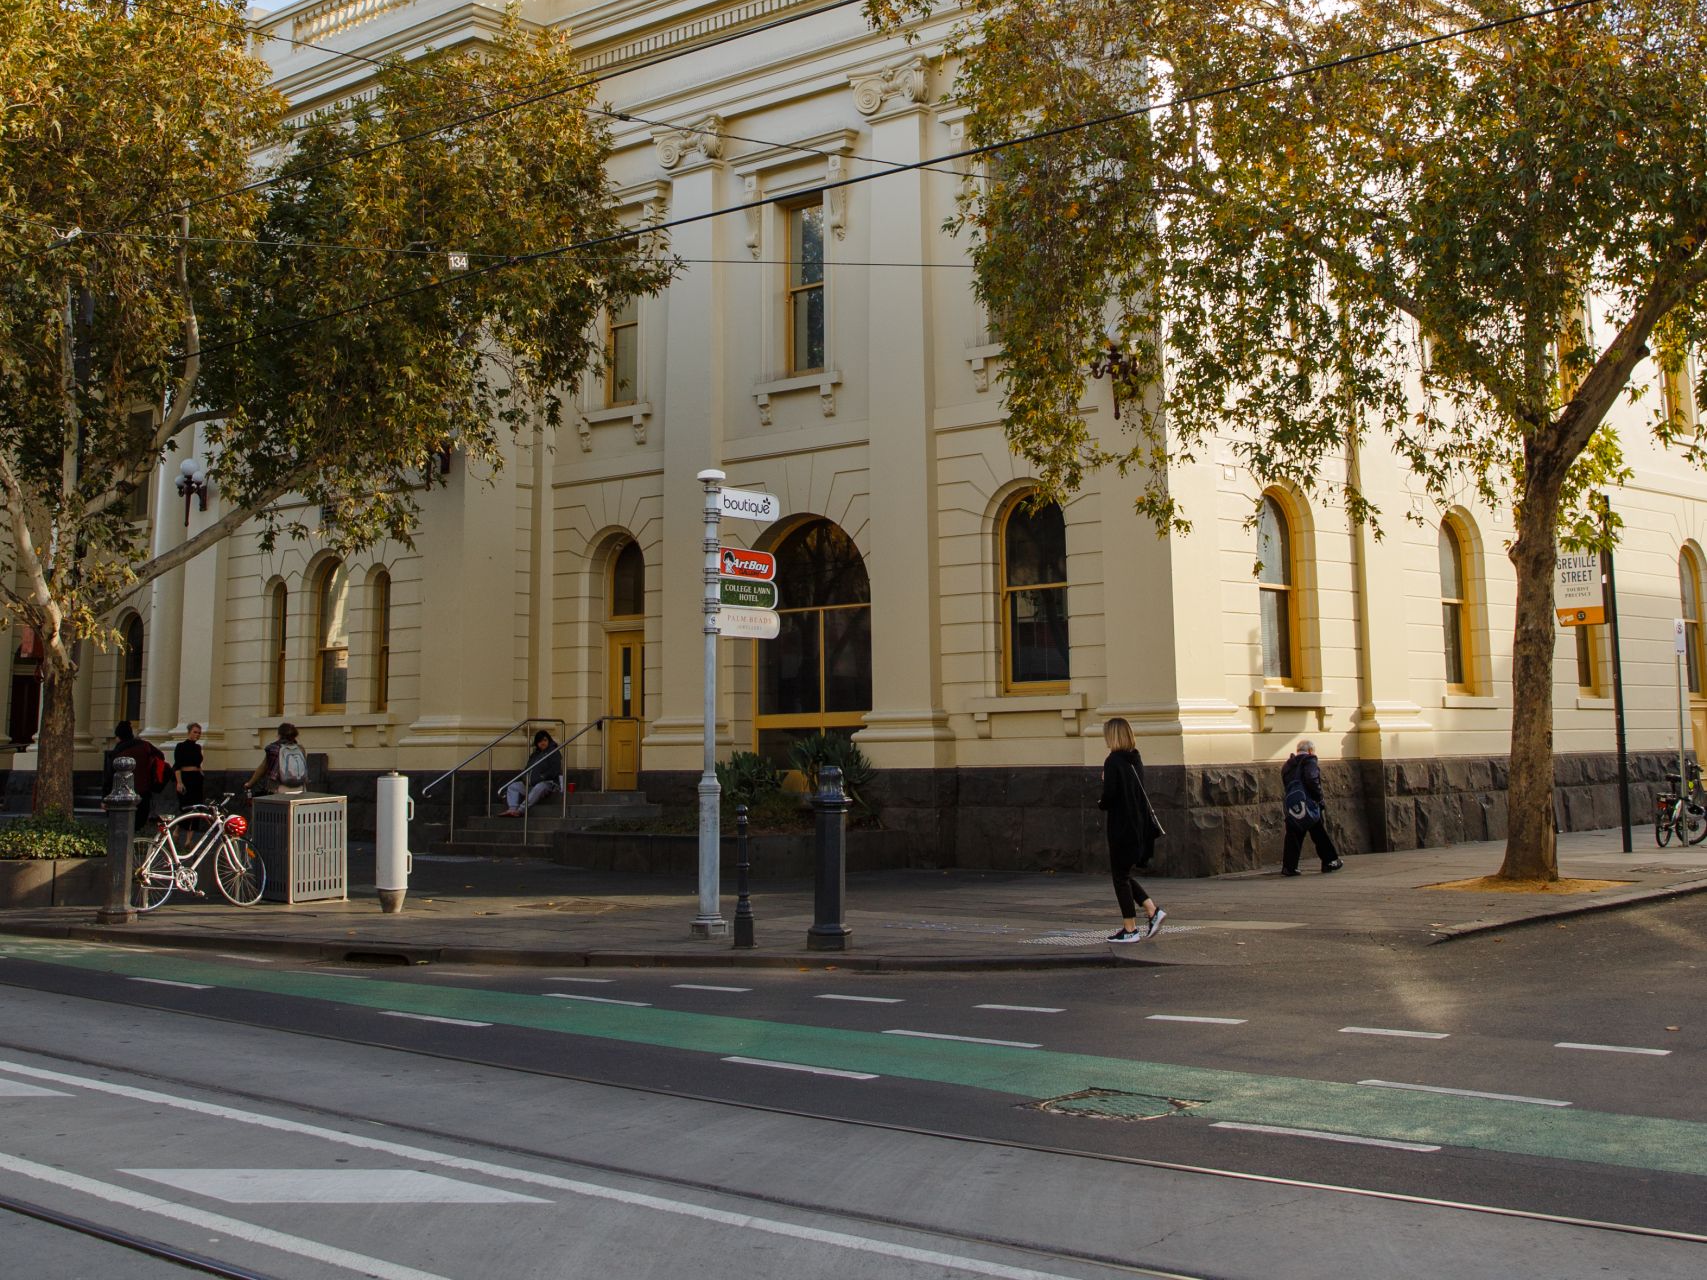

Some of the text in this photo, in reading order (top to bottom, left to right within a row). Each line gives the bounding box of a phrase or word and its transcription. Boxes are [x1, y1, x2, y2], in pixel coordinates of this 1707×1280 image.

[450, 256, 466, 268] 134
[723, 495, 770, 517] boutique
[734, 559, 769, 574] ArtBoy
[1557, 556, 1596, 570] GREVILLE
[1561, 570, 1592, 583] STREET
[724, 584, 771, 595] COLLEGE LAWN
[739, 593, 759, 602] HOTEL
[727, 614, 747, 623] PALM
